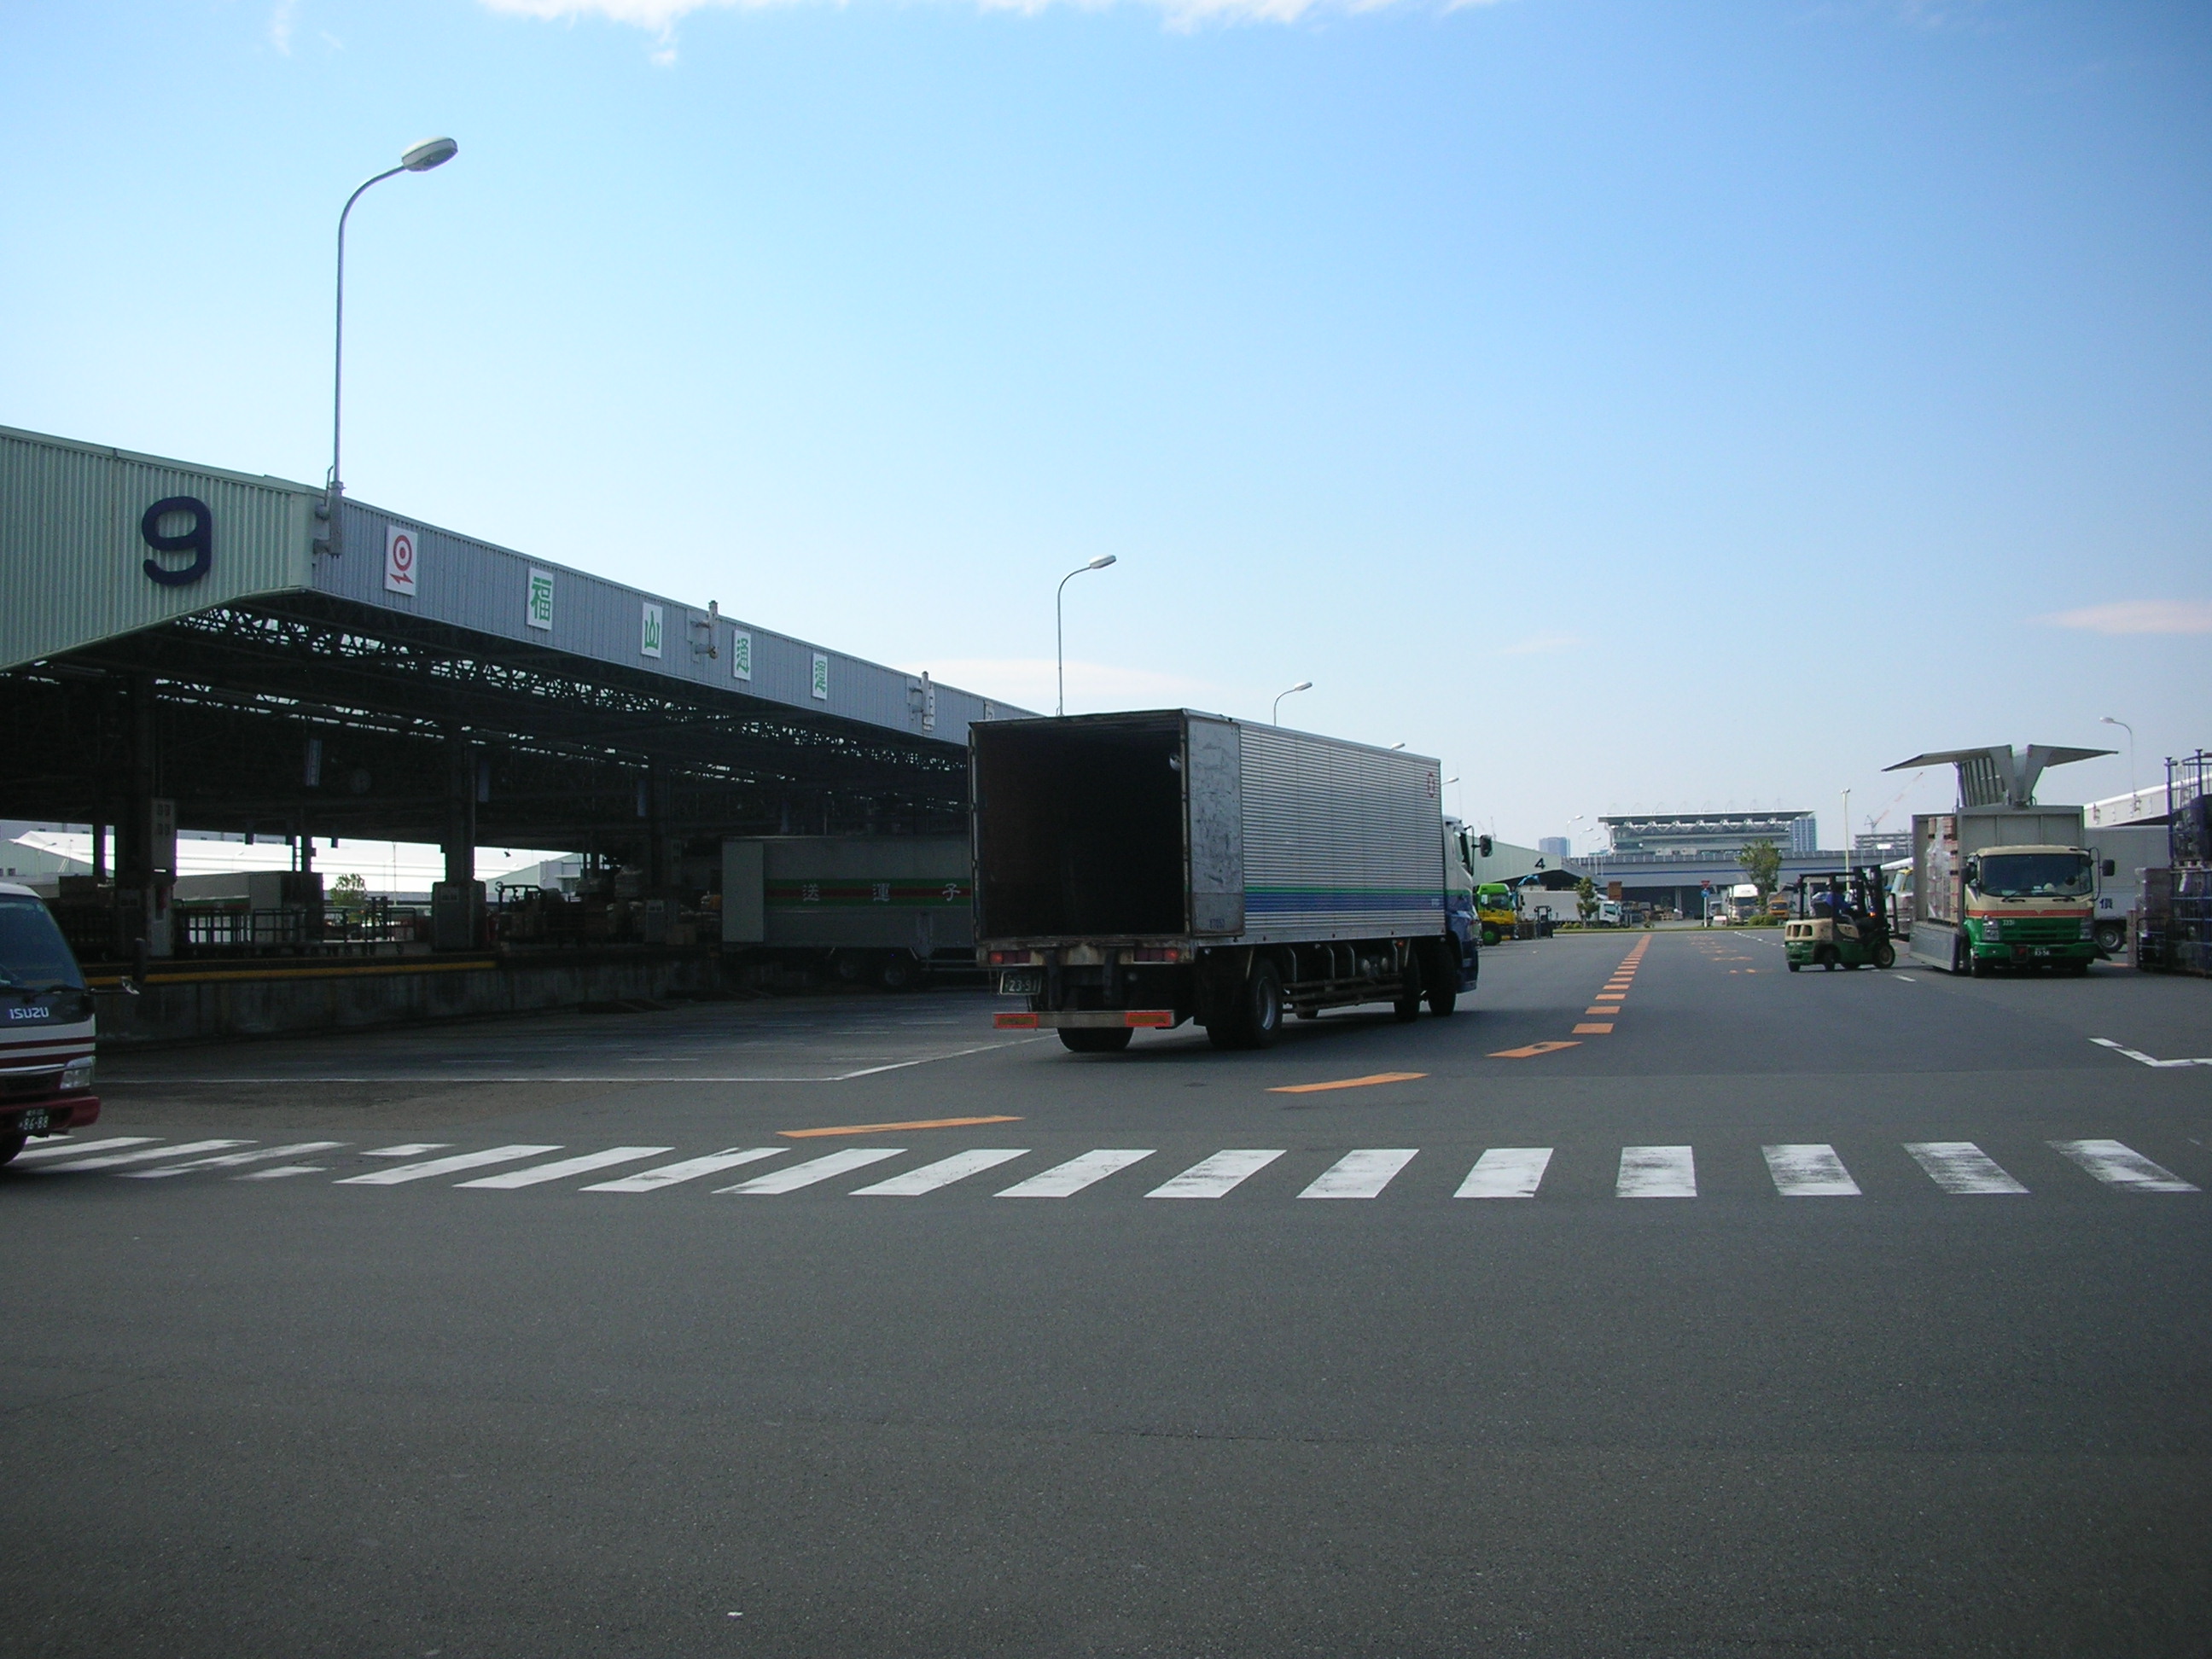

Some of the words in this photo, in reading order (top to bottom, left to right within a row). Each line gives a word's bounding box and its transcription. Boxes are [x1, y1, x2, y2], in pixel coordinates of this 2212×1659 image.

[142, 496, 212, 586] 9
[530, 576, 552, 621] 福
[644, 610, 660, 650] 山
[1534, 857, 1546, 870] 4
[942, 882, 961, 902] 子
[9, 1006, 49, 1020] ISUZU
